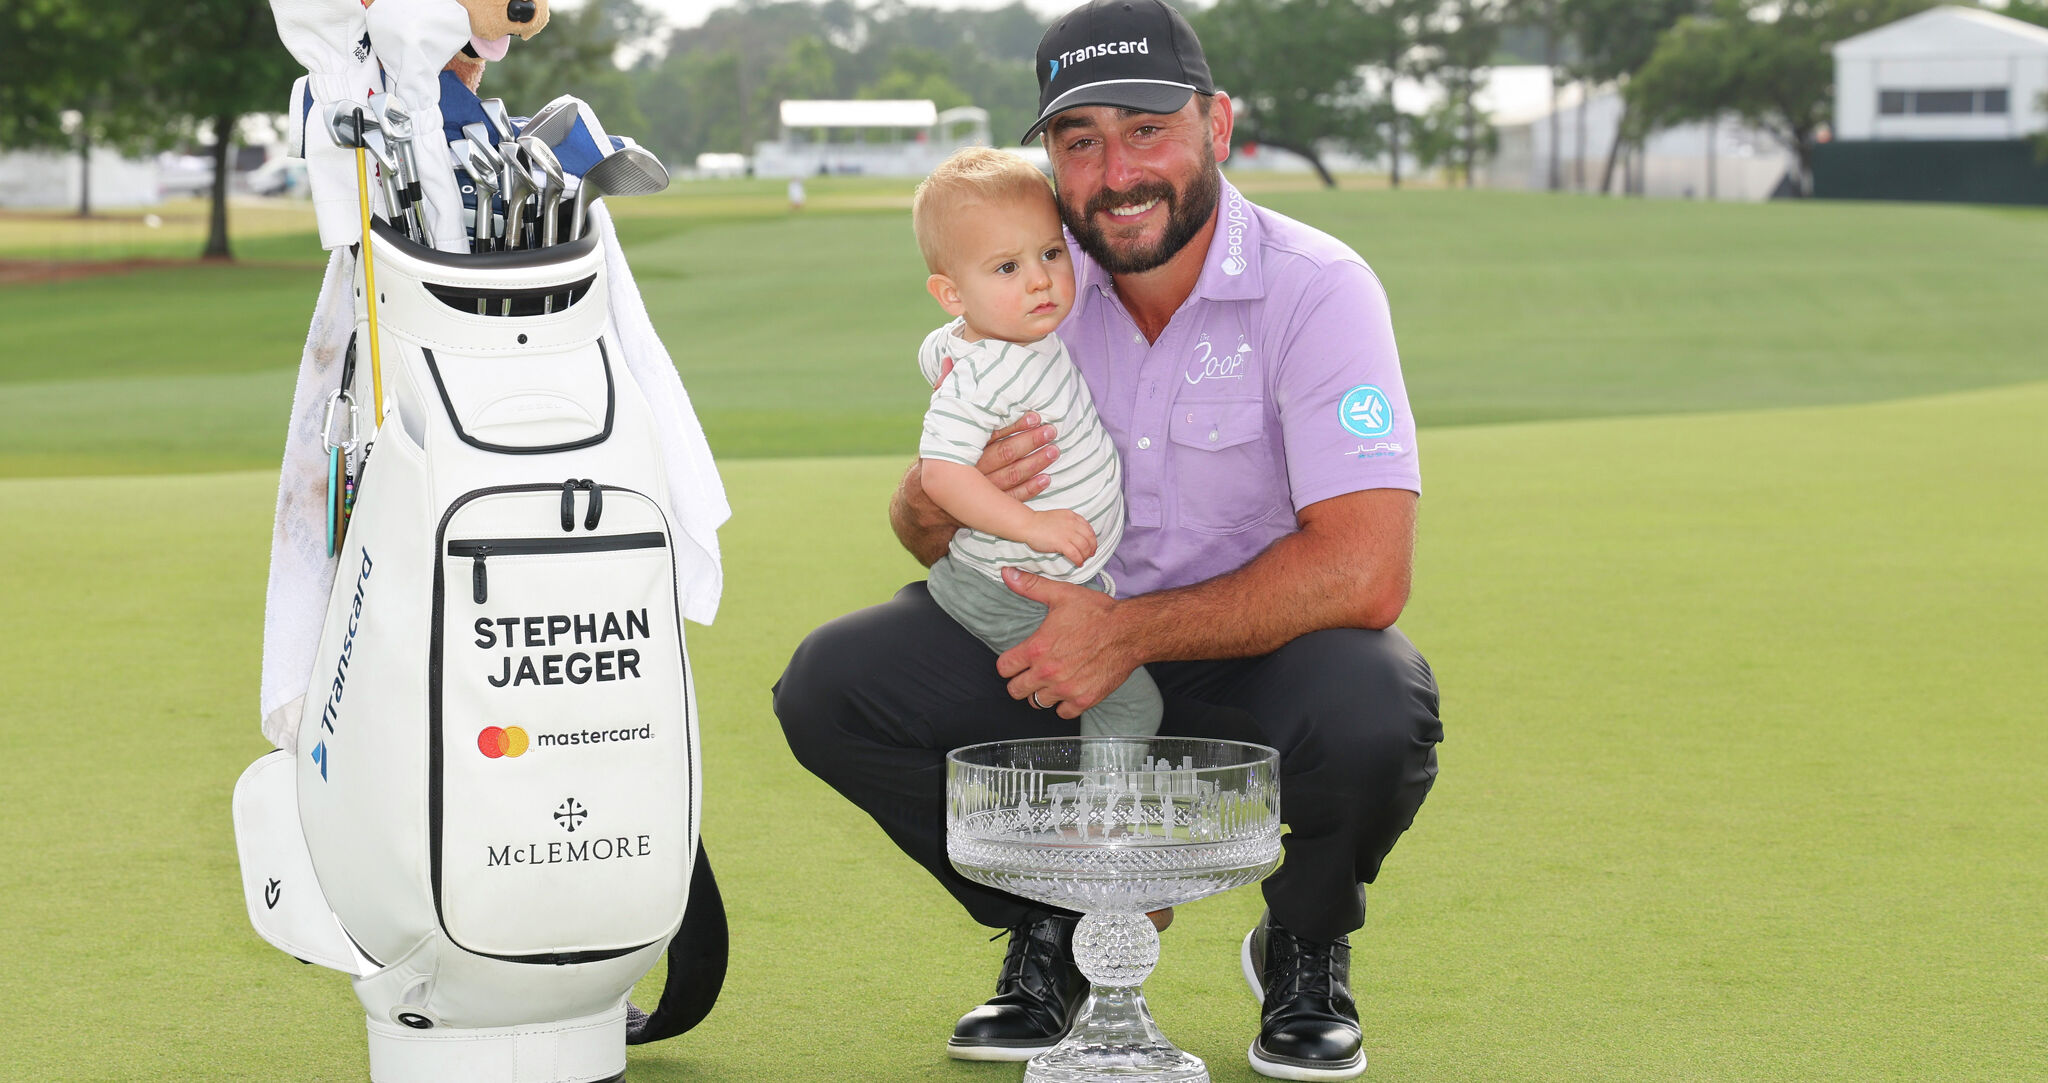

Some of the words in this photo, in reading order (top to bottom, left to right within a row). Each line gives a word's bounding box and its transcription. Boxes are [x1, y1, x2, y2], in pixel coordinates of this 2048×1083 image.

[352, 46, 367, 64] 1896
[1060, 37, 1149, 69] Transcard
[321, 545, 373, 736] Transcard
[474, 608, 650, 649] STEPHAN
[487, 648, 641, 688] JAEGER
[537, 723, 651, 746] mastercard
[487, 834, 651, 867] McLEMORE
